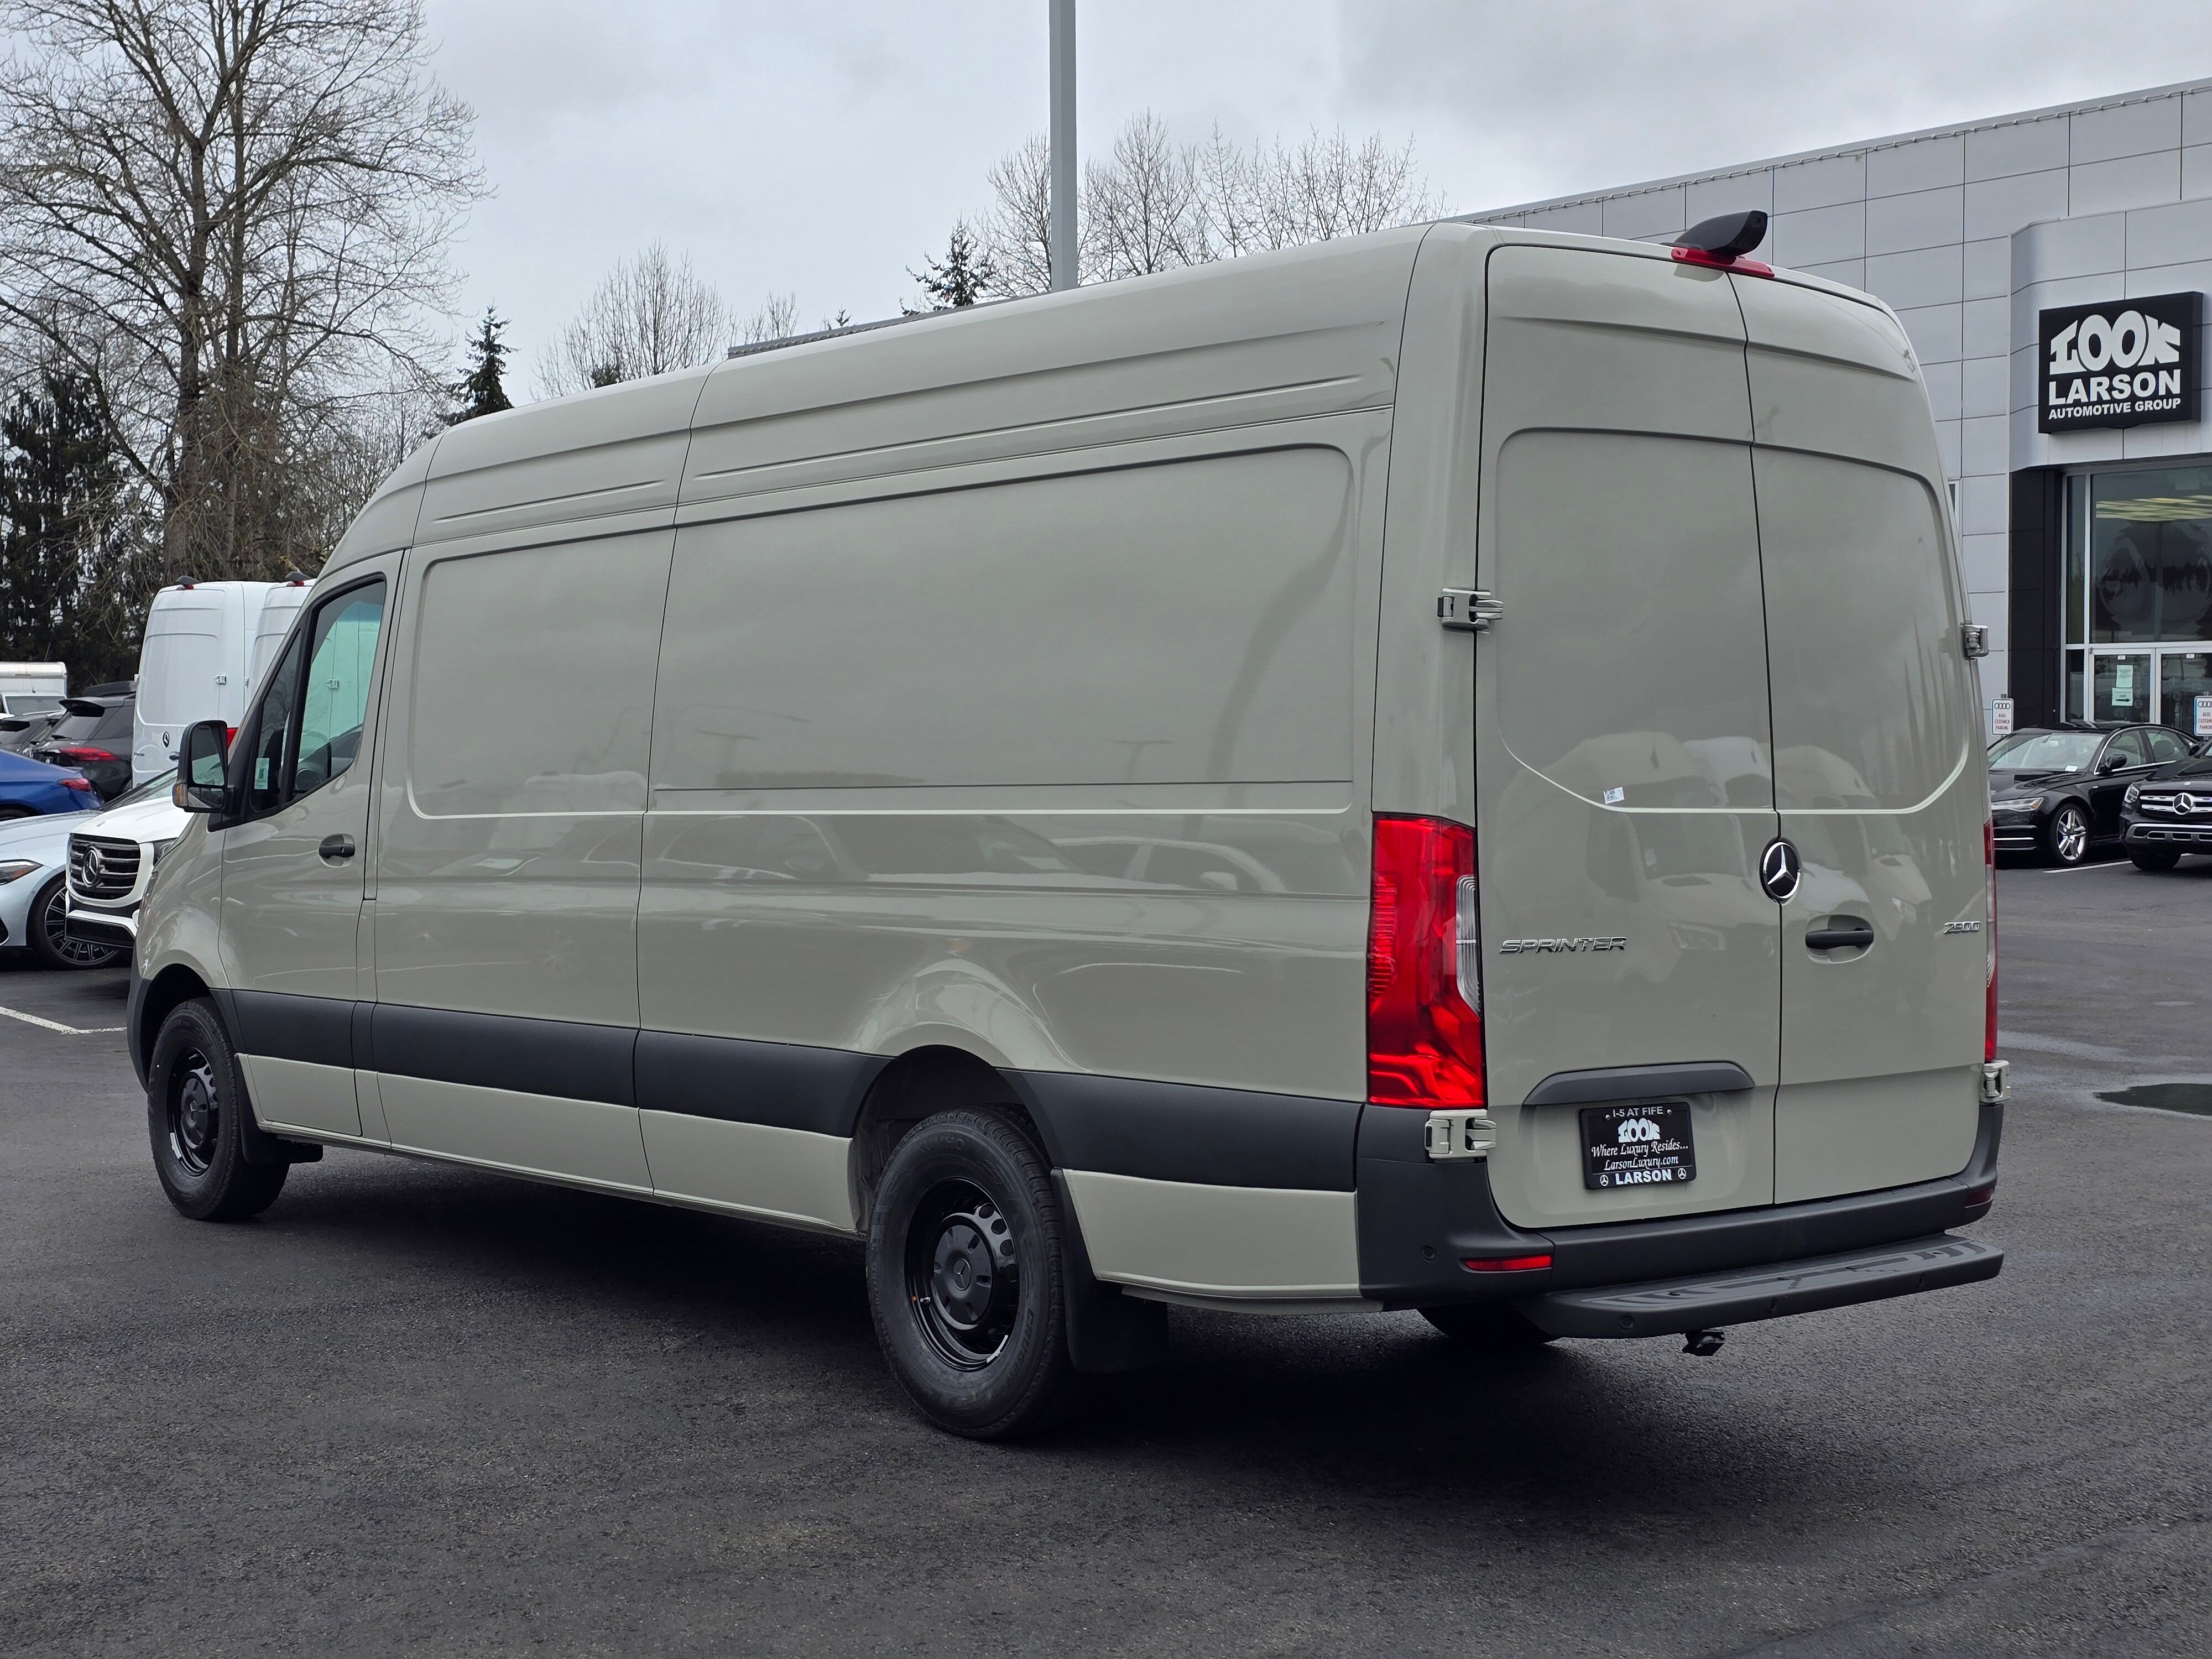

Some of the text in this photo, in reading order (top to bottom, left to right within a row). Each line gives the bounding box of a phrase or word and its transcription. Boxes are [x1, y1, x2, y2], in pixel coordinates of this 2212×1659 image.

[2049, 310, 2180, 375] LOOK
[2049, 369, 2181, 405] LARSON
[2048, 398, 2181, 420] AUTOMOTIVE GROUP
[1499, 937, 1627, 954] SPRINTER
[1613, 1106, 1664, 1118] I-5 AT FIFE
[1618, 1118, 1661, 1143] LOOK
[1591, 1138, 1689, 1157] Where Luxury Resides...
[1604, 1155, 1679, 1171] LarsonLuxury.com
[1615, 1168, 1672, 1185] LARSON
